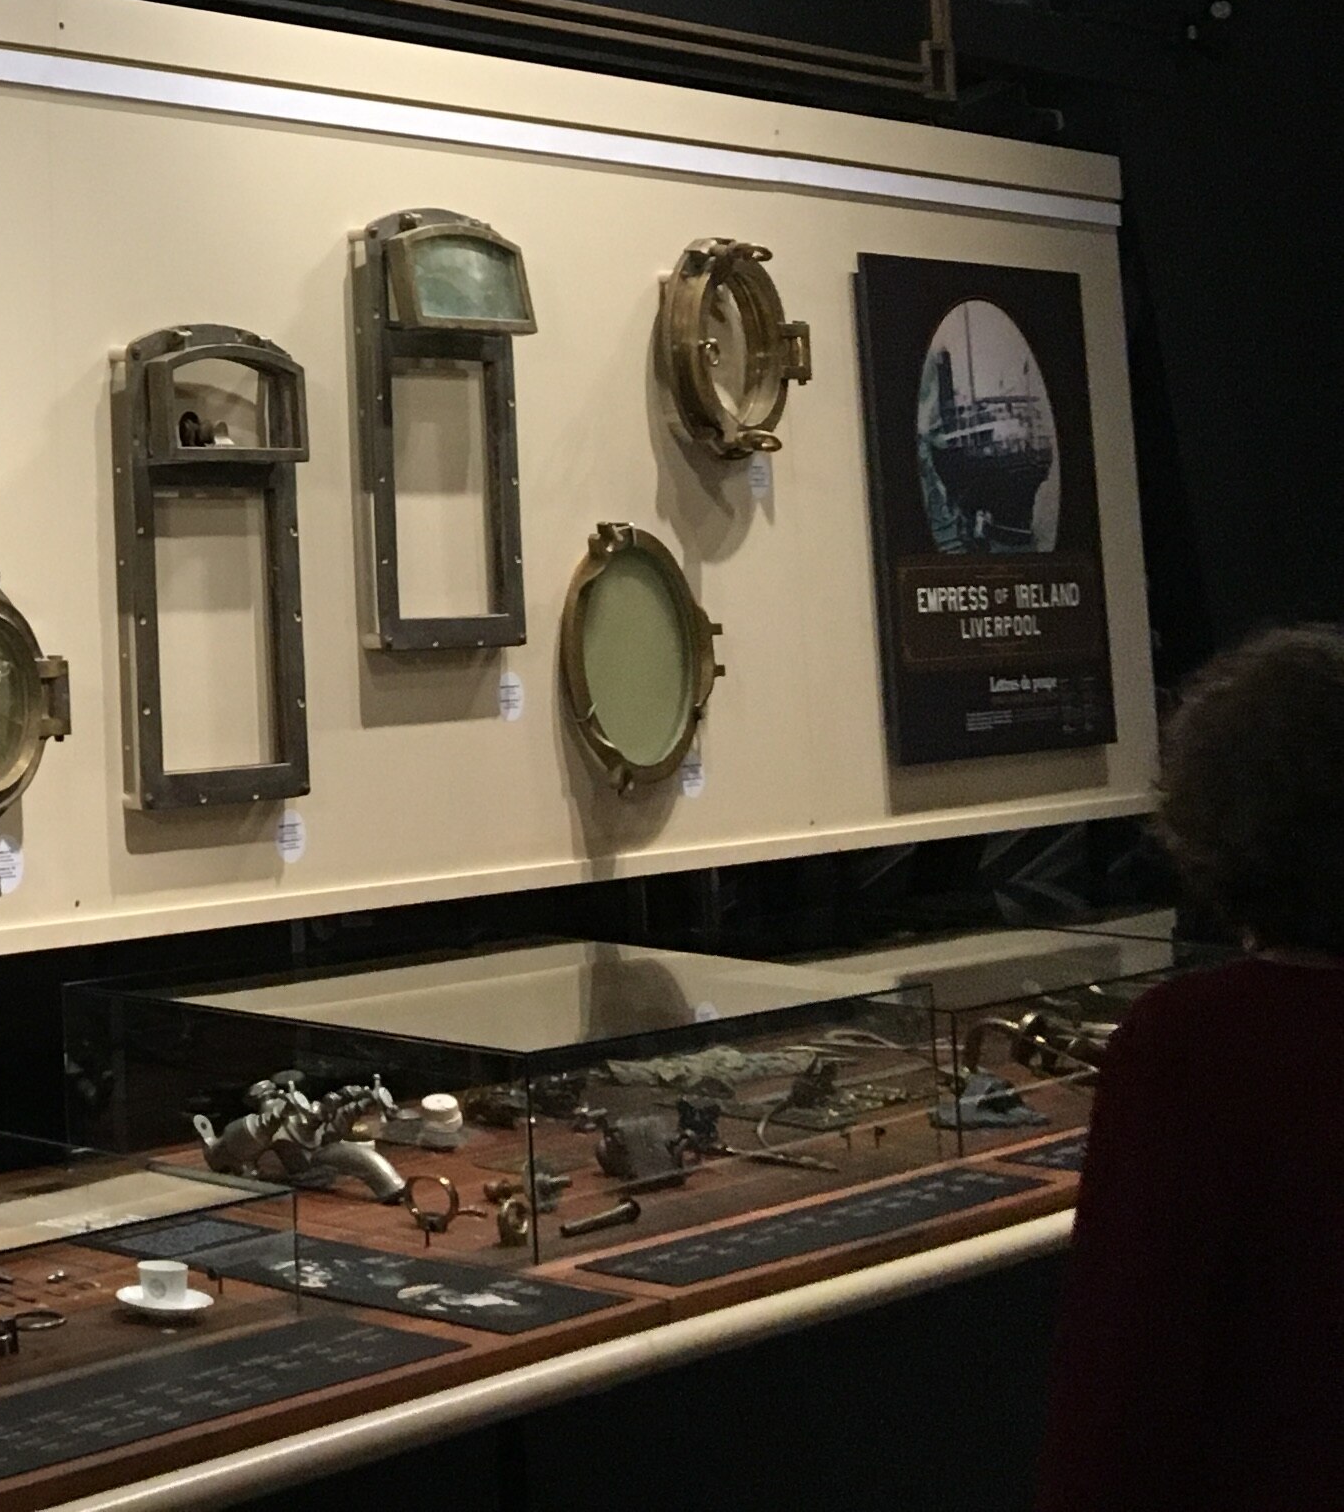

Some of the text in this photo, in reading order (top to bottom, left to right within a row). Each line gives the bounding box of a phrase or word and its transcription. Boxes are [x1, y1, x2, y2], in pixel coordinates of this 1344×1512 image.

[916, 582, 1080, 613] EMPRESS OF IRELAND
[960, 614, 1042, 639] LIVERPOOL
